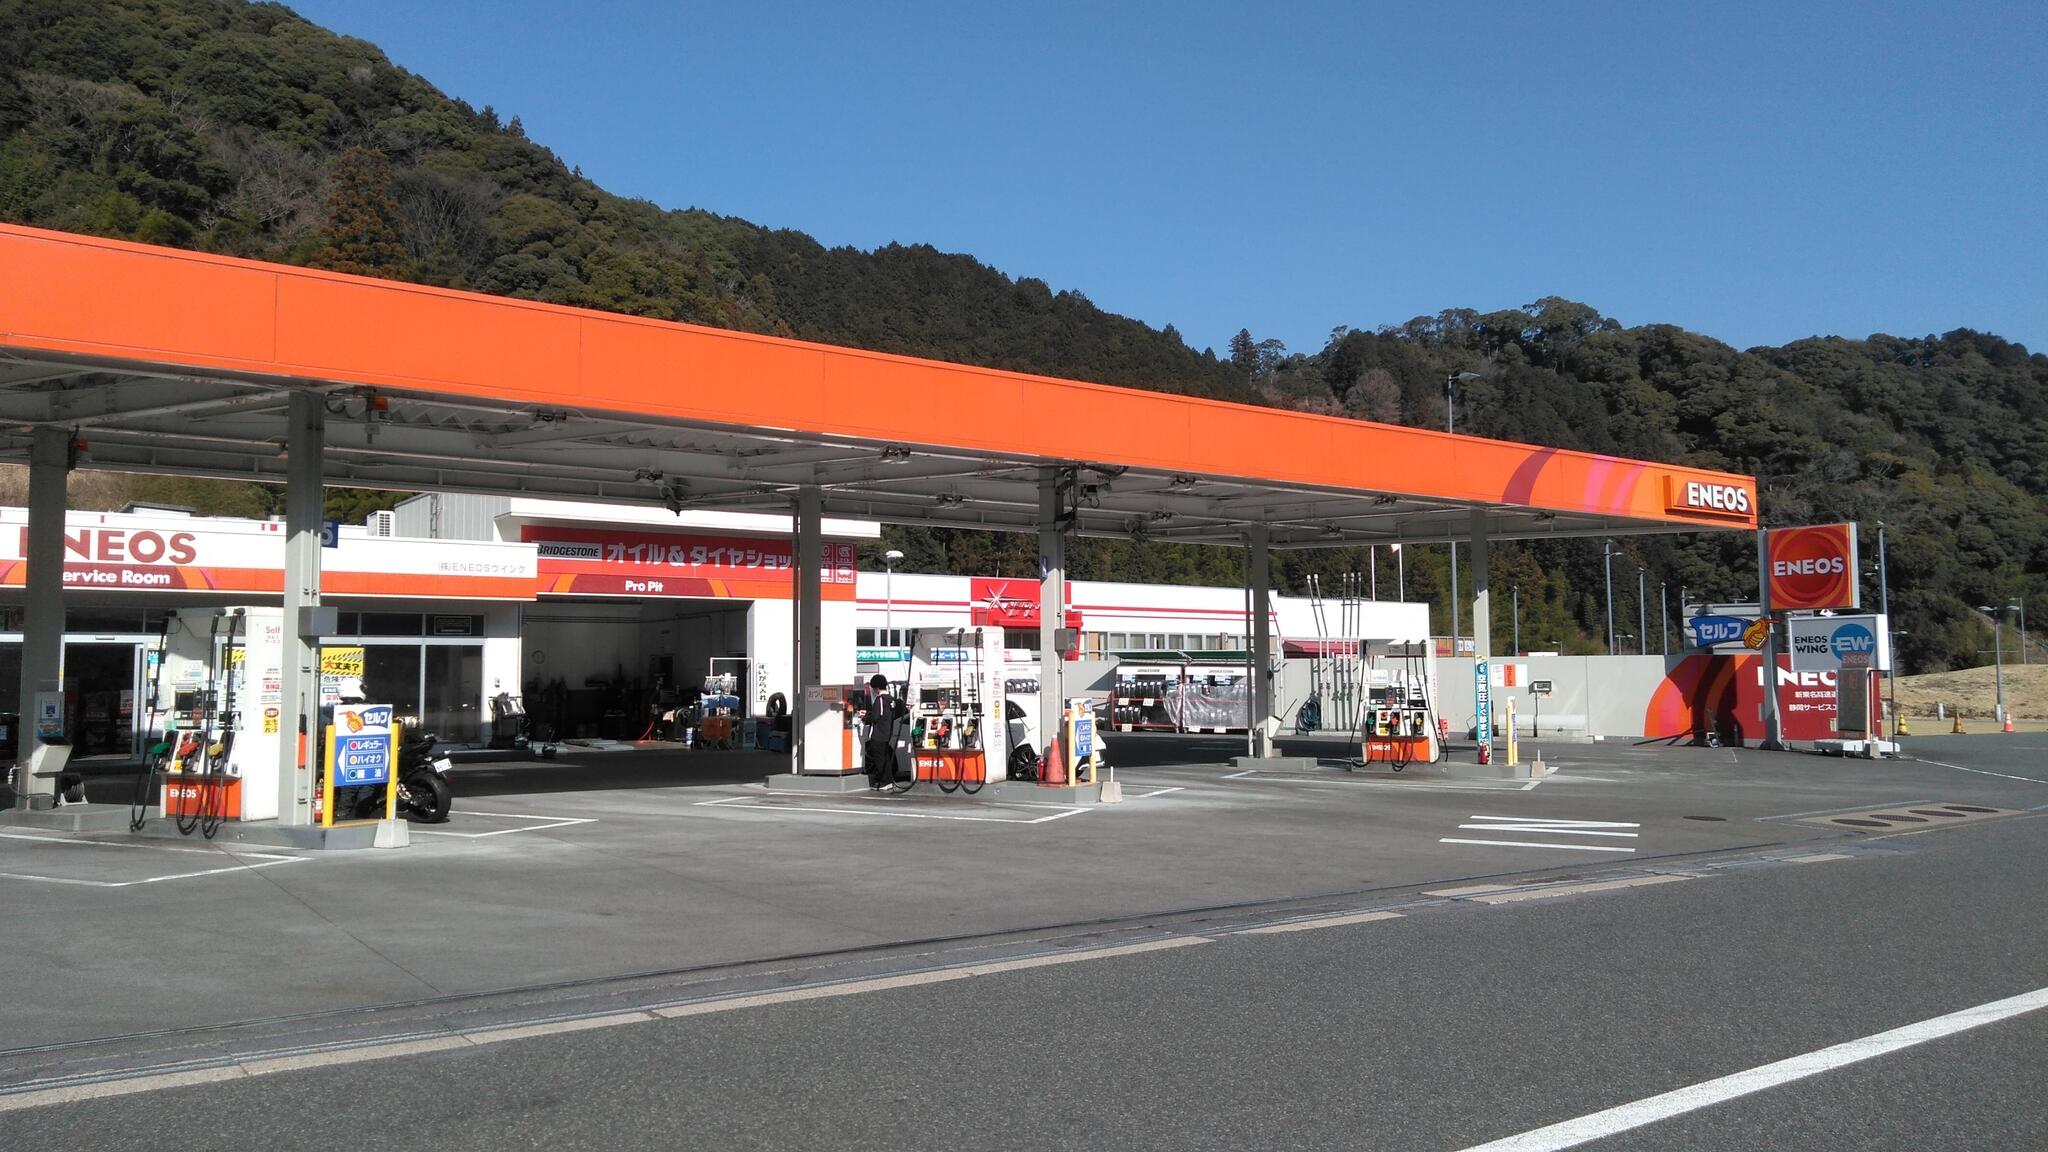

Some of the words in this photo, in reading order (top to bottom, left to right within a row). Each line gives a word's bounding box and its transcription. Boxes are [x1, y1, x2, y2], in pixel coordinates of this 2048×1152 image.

[1687, 482, 1748, 512] ENEOS
[19, 526, 197, 565] NEOS
[537, 544, 600, 557] BRIDGESTONE
[607, 543, 793, 570] オイル&タイヤショッ
[1774, 556, 1844, 577] ENEOS
[63, 570, 117, 583] ervice
[121, 569, 170, 585] Room
[625, 580, 646, 592] Pro
[648, 581, 664, 593] Pit
[1699, 622, 1742, 640] セルフ
[1795, 635, 1828, 644] ENEOS
[1835, 635, 1870, 652] EW
[1796, 645, 1828, 654] WING
[324, 660, 360, 671] 大丈夫?
[363, 711, 389, 725] セルフ
[357, 740, 383, 750] レギュラー
[357, 754, 382, 764] ハイオク
